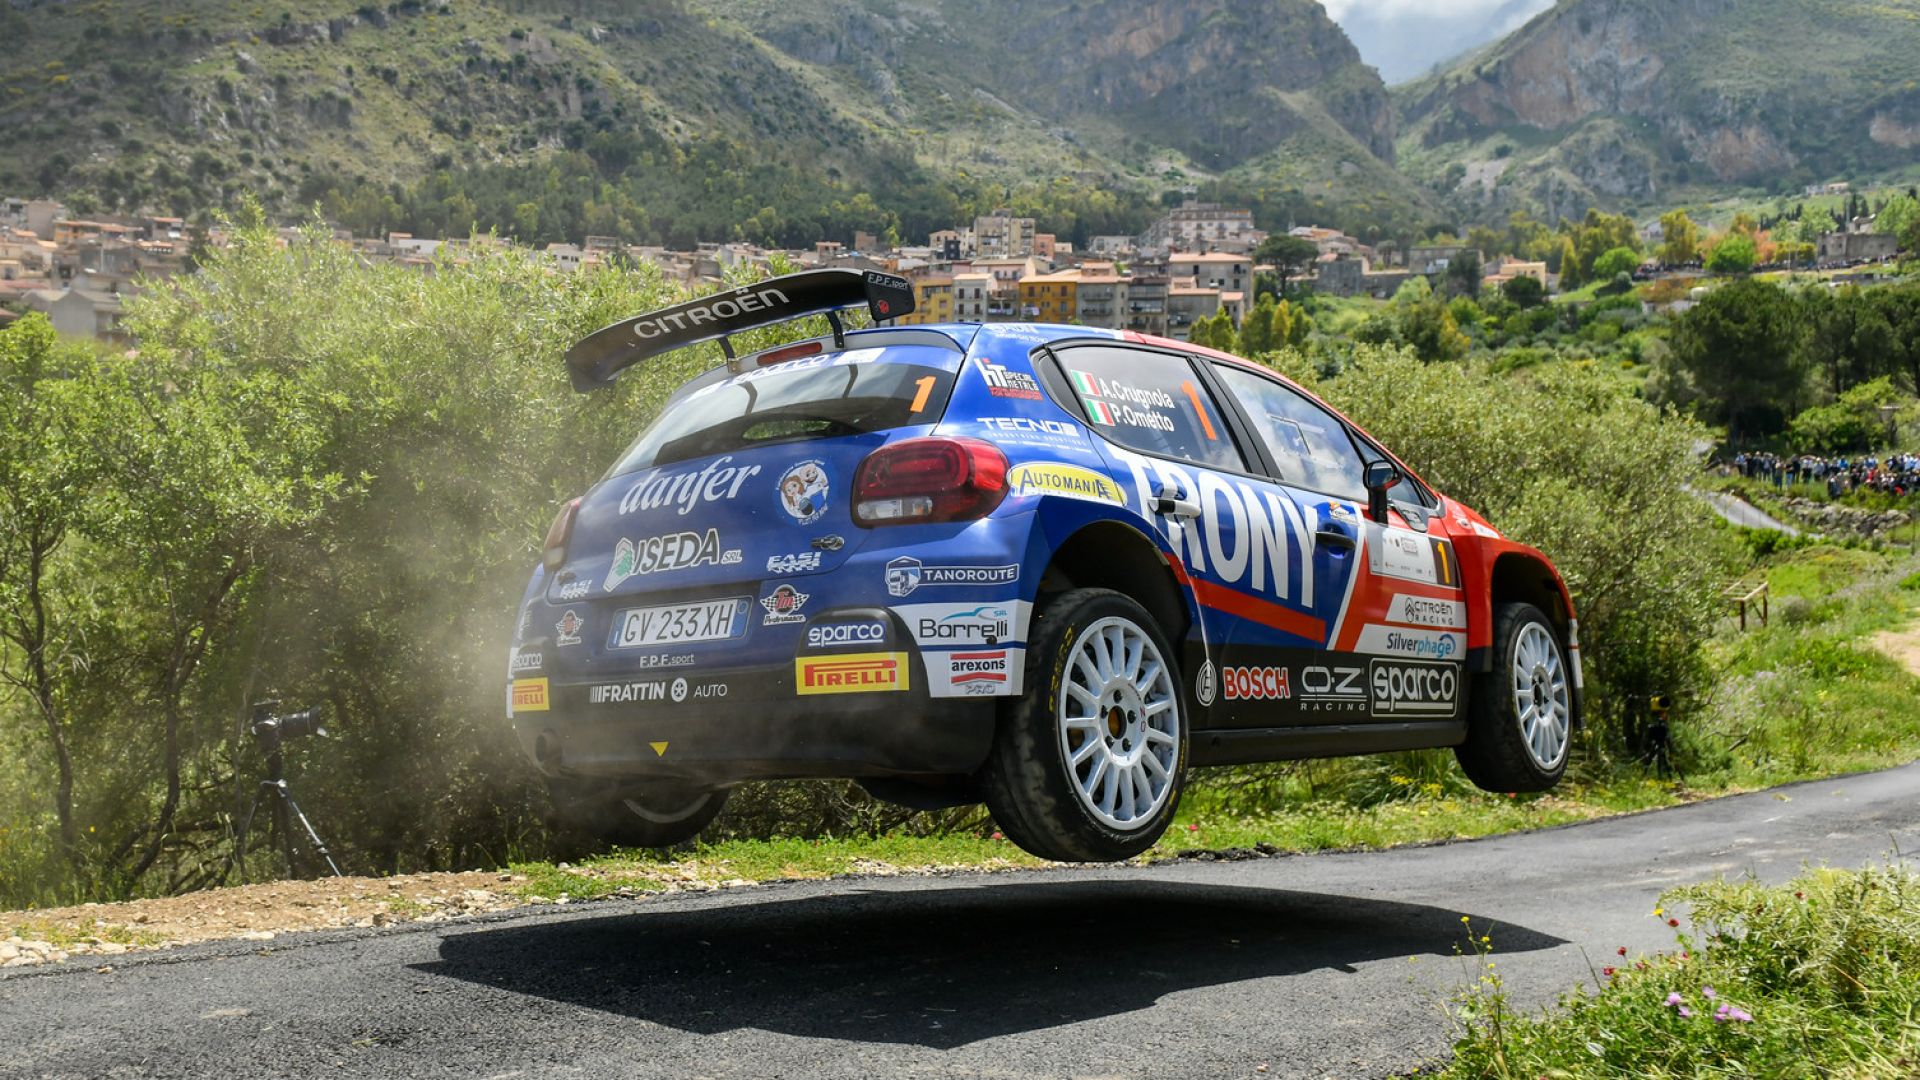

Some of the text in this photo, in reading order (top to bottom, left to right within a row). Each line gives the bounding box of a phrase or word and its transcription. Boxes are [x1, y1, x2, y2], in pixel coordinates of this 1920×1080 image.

[910, 375, 937, 412] 1
[1099, 377, 1175, 409] A.Crugnola
[1109, 402, 1175, 432] P.Ometto
[1181, 379, 1217, 441] 1
[618, 455, 762, 515] danfer
[1104, 443, 1318, 608] TRONY
[924, 568, 1015, 582] TANOROUTE
[1437, 542, 1450, 584] 1
[624, 612, 654, 642] GV
[808, 622, 884, 646] sparco
[919, 618, 1008, 639] Borrelli
[1415, 614, 1454, 625] RACING
[1386, 633, 1455, 658] Silverphage
[804, 659, 897, 687] PIRELLI
[951, 657, 1006, 672] arexons
[601, 682, 728, 702] FRATTIN AUTO
[1223, 666, 1291, 700] BOSCH
[1373, 666, 1456, 712] sparco
[1301, 703, 1367, 711] RACING
